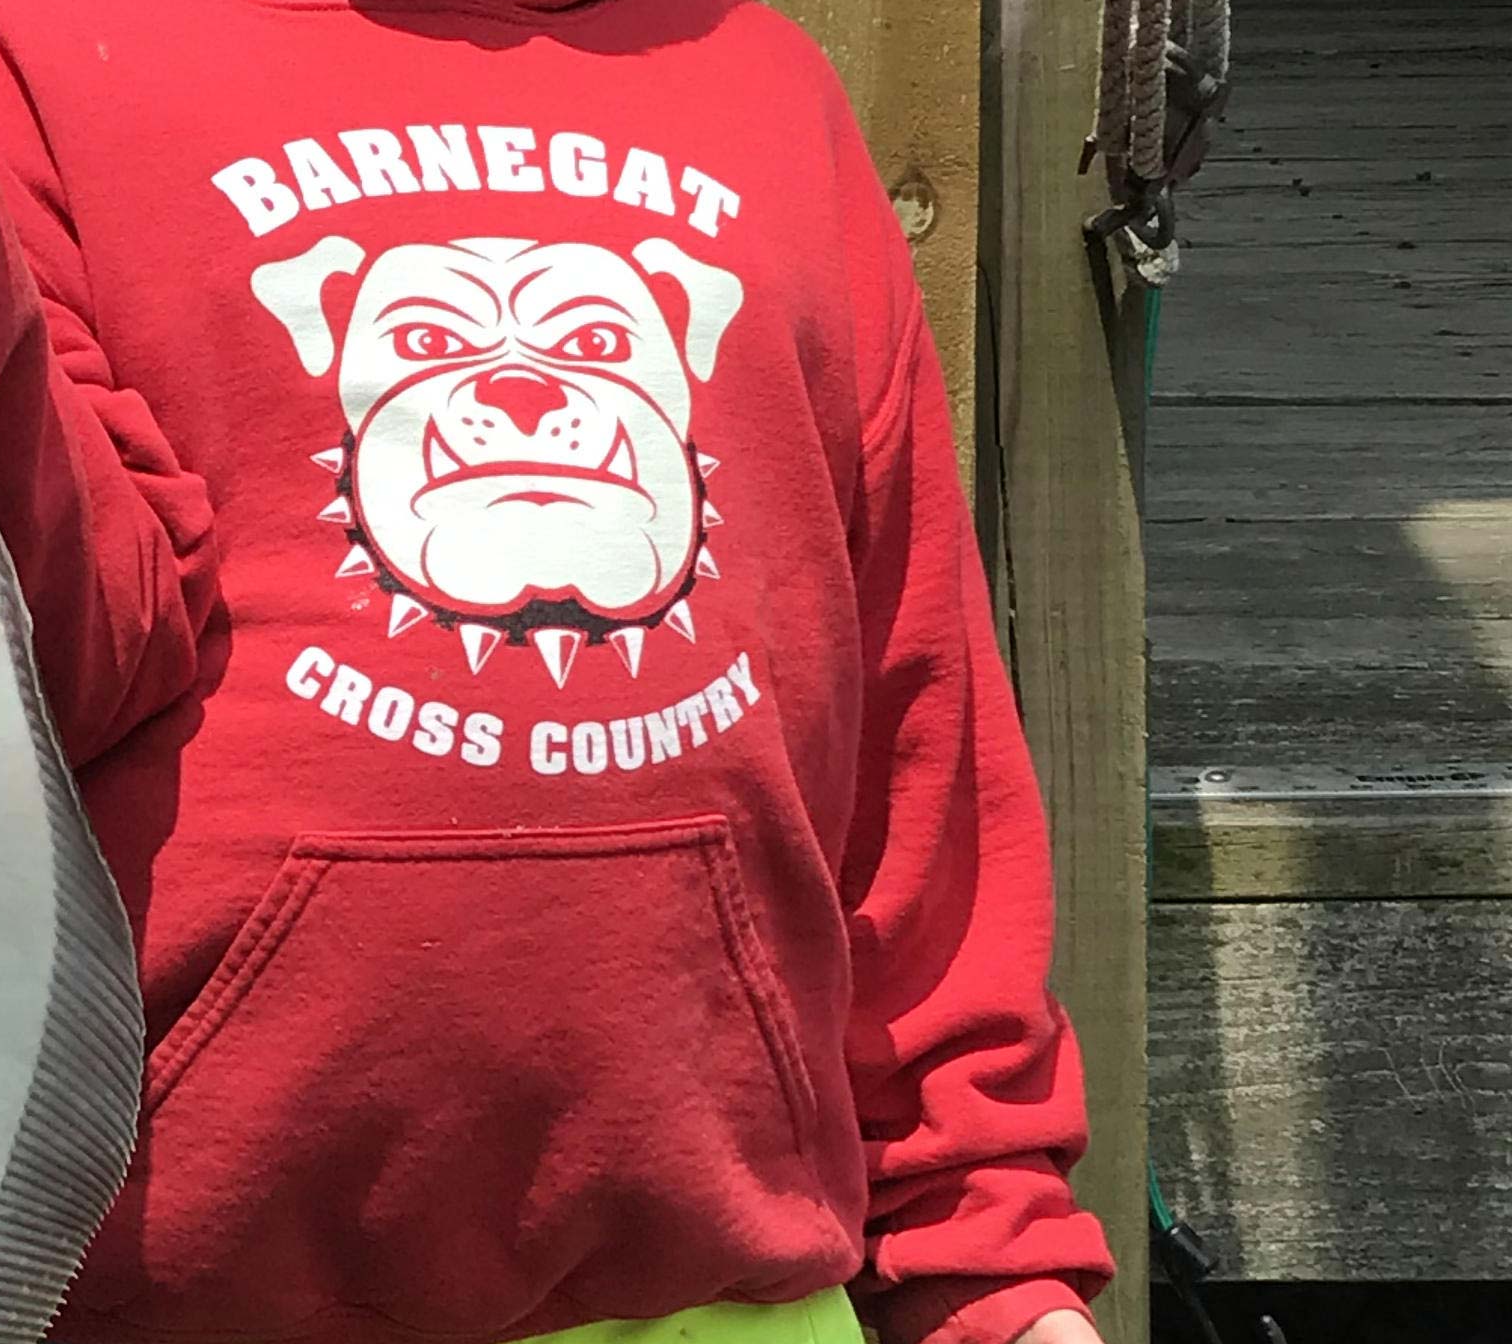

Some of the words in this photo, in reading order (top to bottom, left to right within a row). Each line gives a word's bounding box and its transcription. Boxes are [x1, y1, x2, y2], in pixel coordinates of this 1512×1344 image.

[210, 123, 741, 239] BARNEGAT
[285, 646, 504, 767] CROSS
[529, 651, 763, 775] COUNTRY
